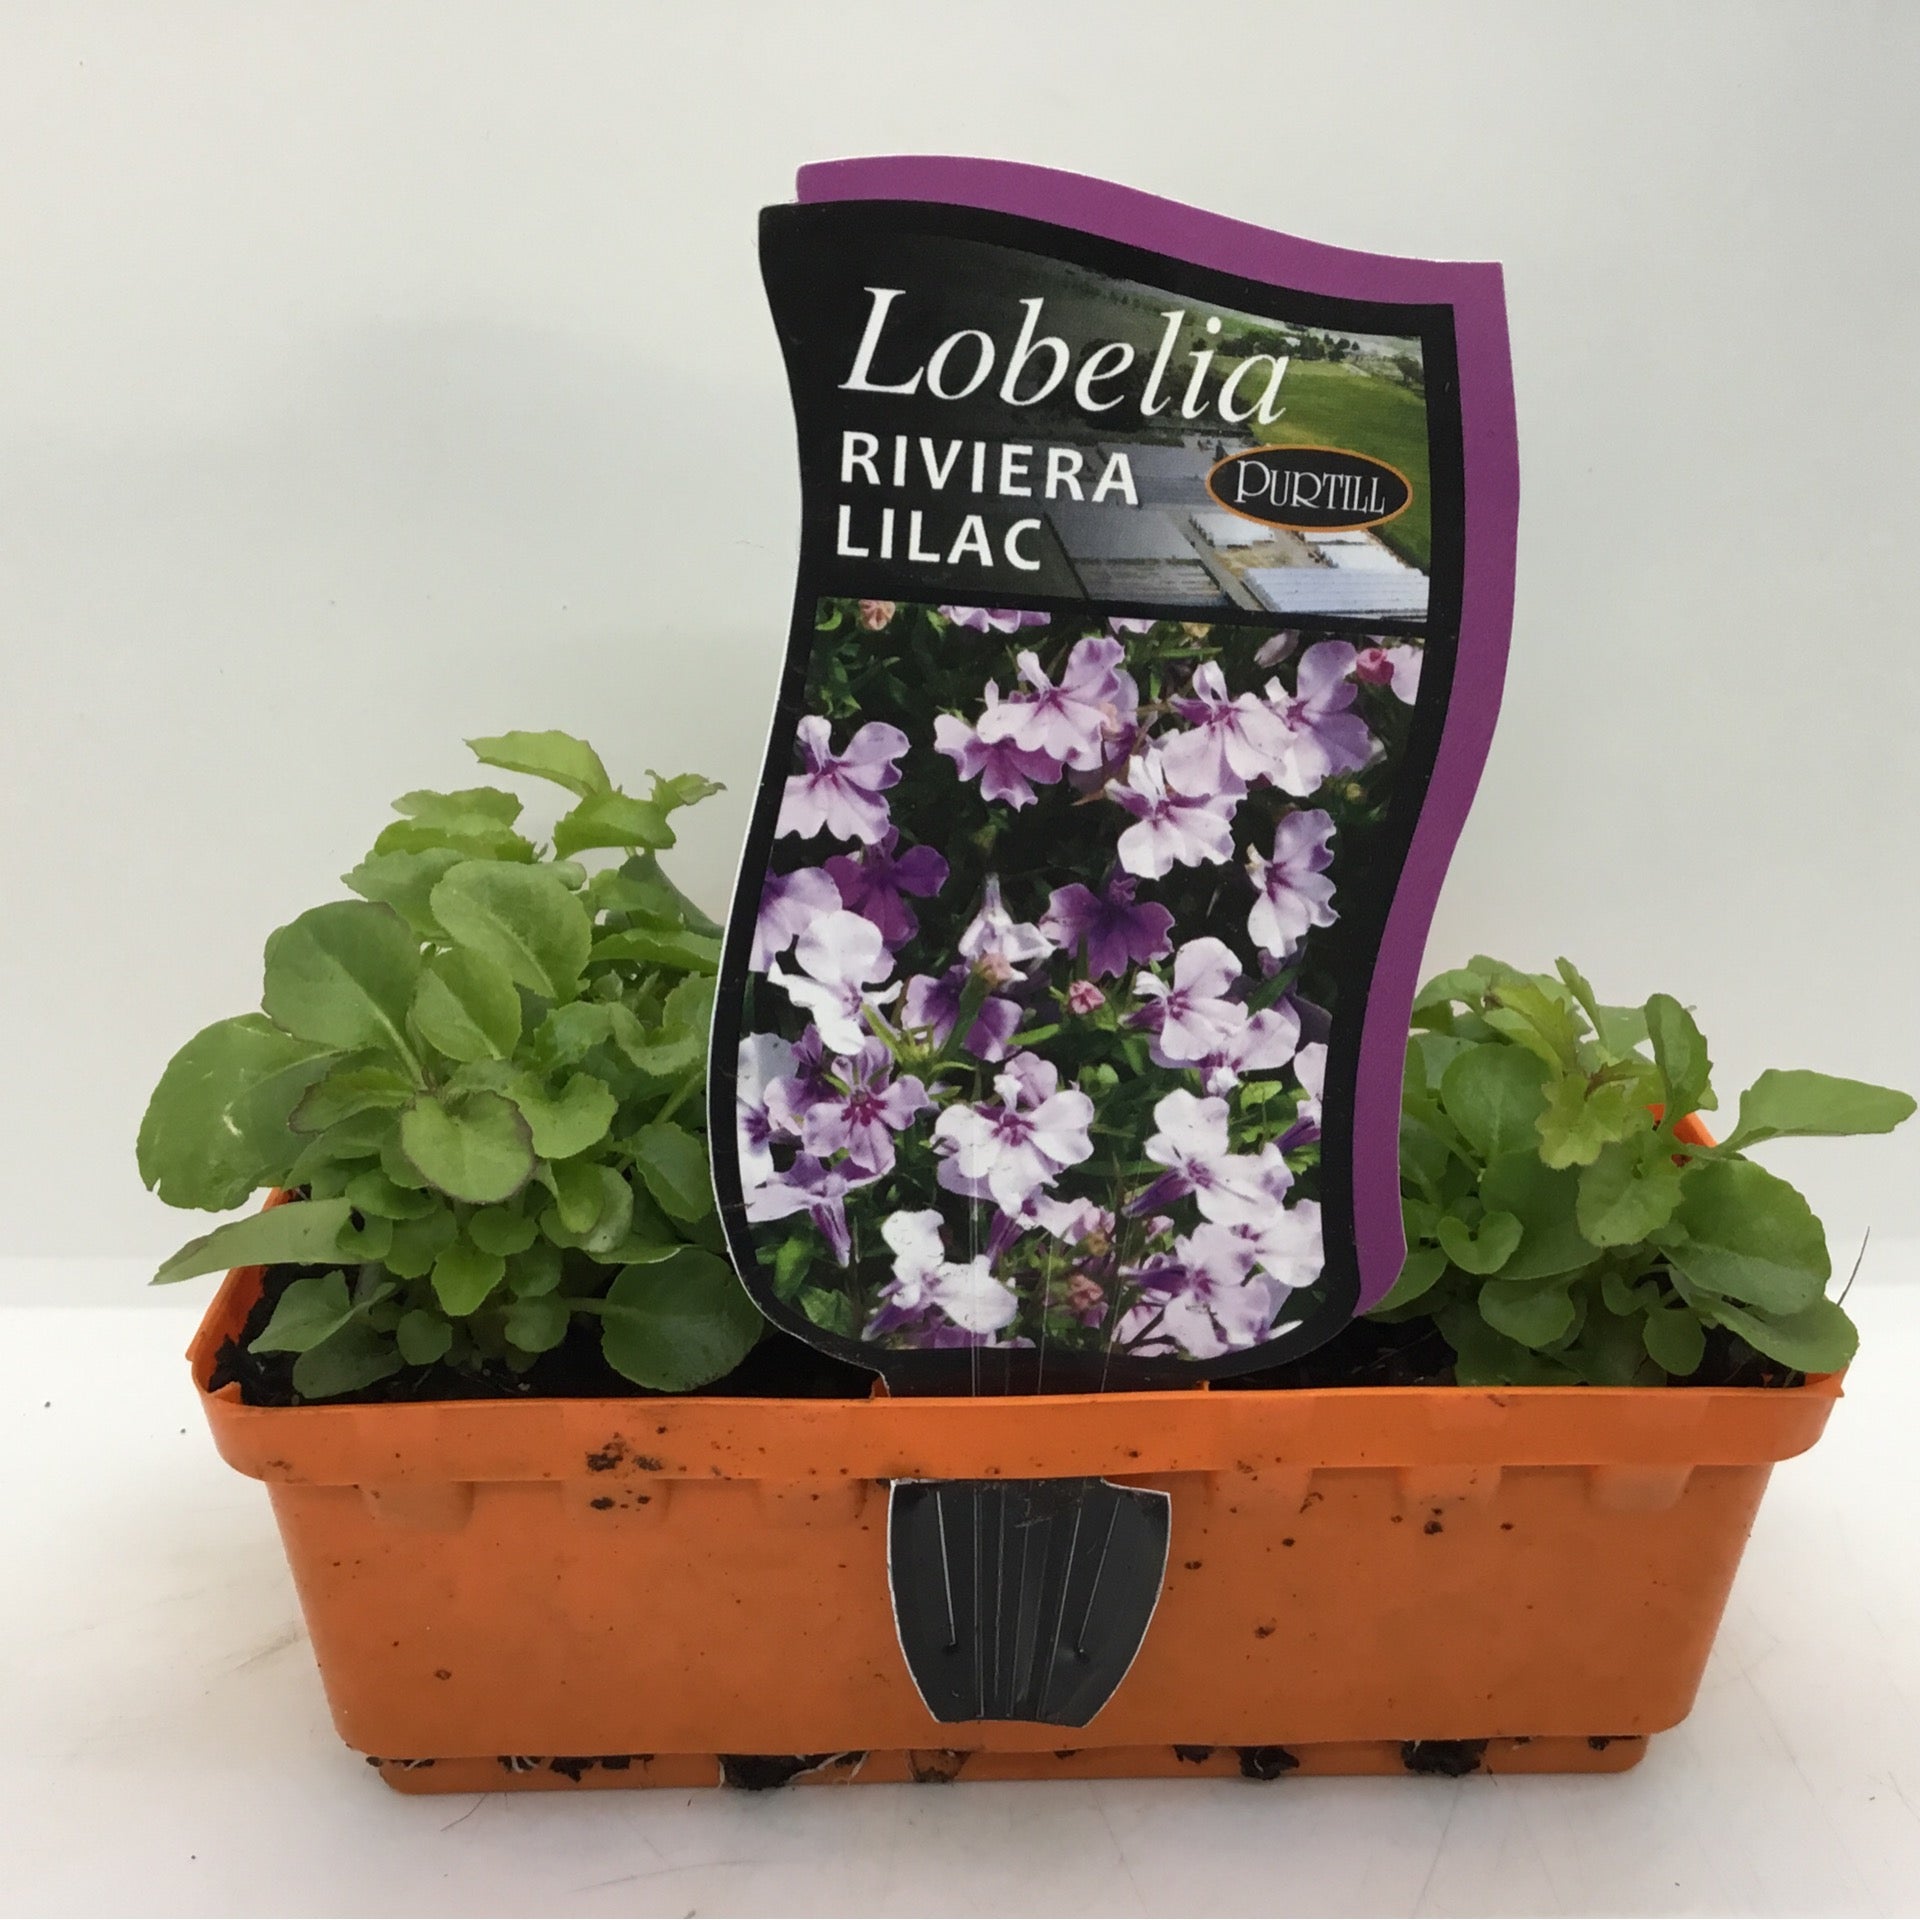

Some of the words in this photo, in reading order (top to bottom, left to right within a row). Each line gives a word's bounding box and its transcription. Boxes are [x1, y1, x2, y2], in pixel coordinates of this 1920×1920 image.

[838, 286, 1290, 425] Lobelia
[840, 431, 1139, 506] RIVIERA
[1233, 459, 1386, 517] PURTILL
[836, 506, 1043, 572] LILAC
